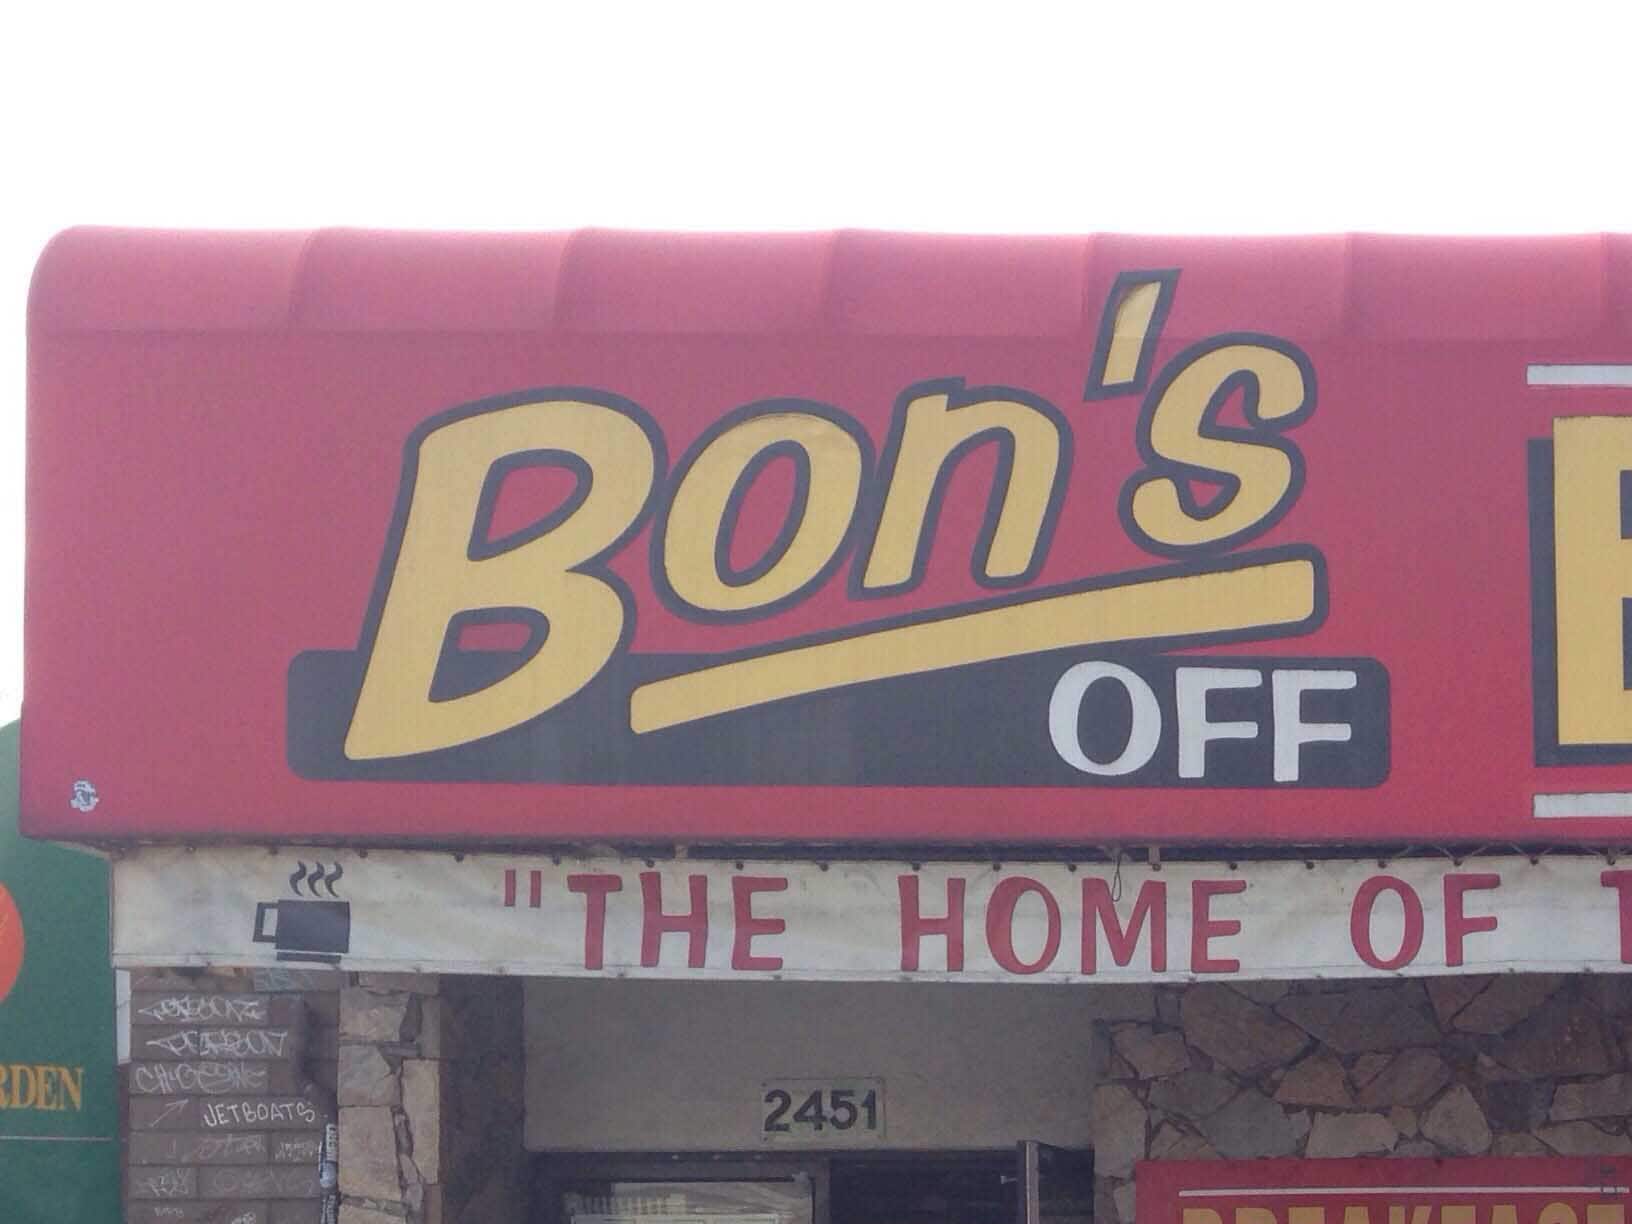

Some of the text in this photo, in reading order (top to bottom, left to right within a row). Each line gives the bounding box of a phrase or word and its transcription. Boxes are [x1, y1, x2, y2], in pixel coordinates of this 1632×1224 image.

[344, 269, 1318, 760] Bon's
[1048, 660, 1358, 782] OFF
[898, 875, 1247, 975] HOME
[1350, 872, 1501, 970] OF
[203, 1102, 316, 1128] JETBOATS
[763, 1089, 879, 1133] 2451
